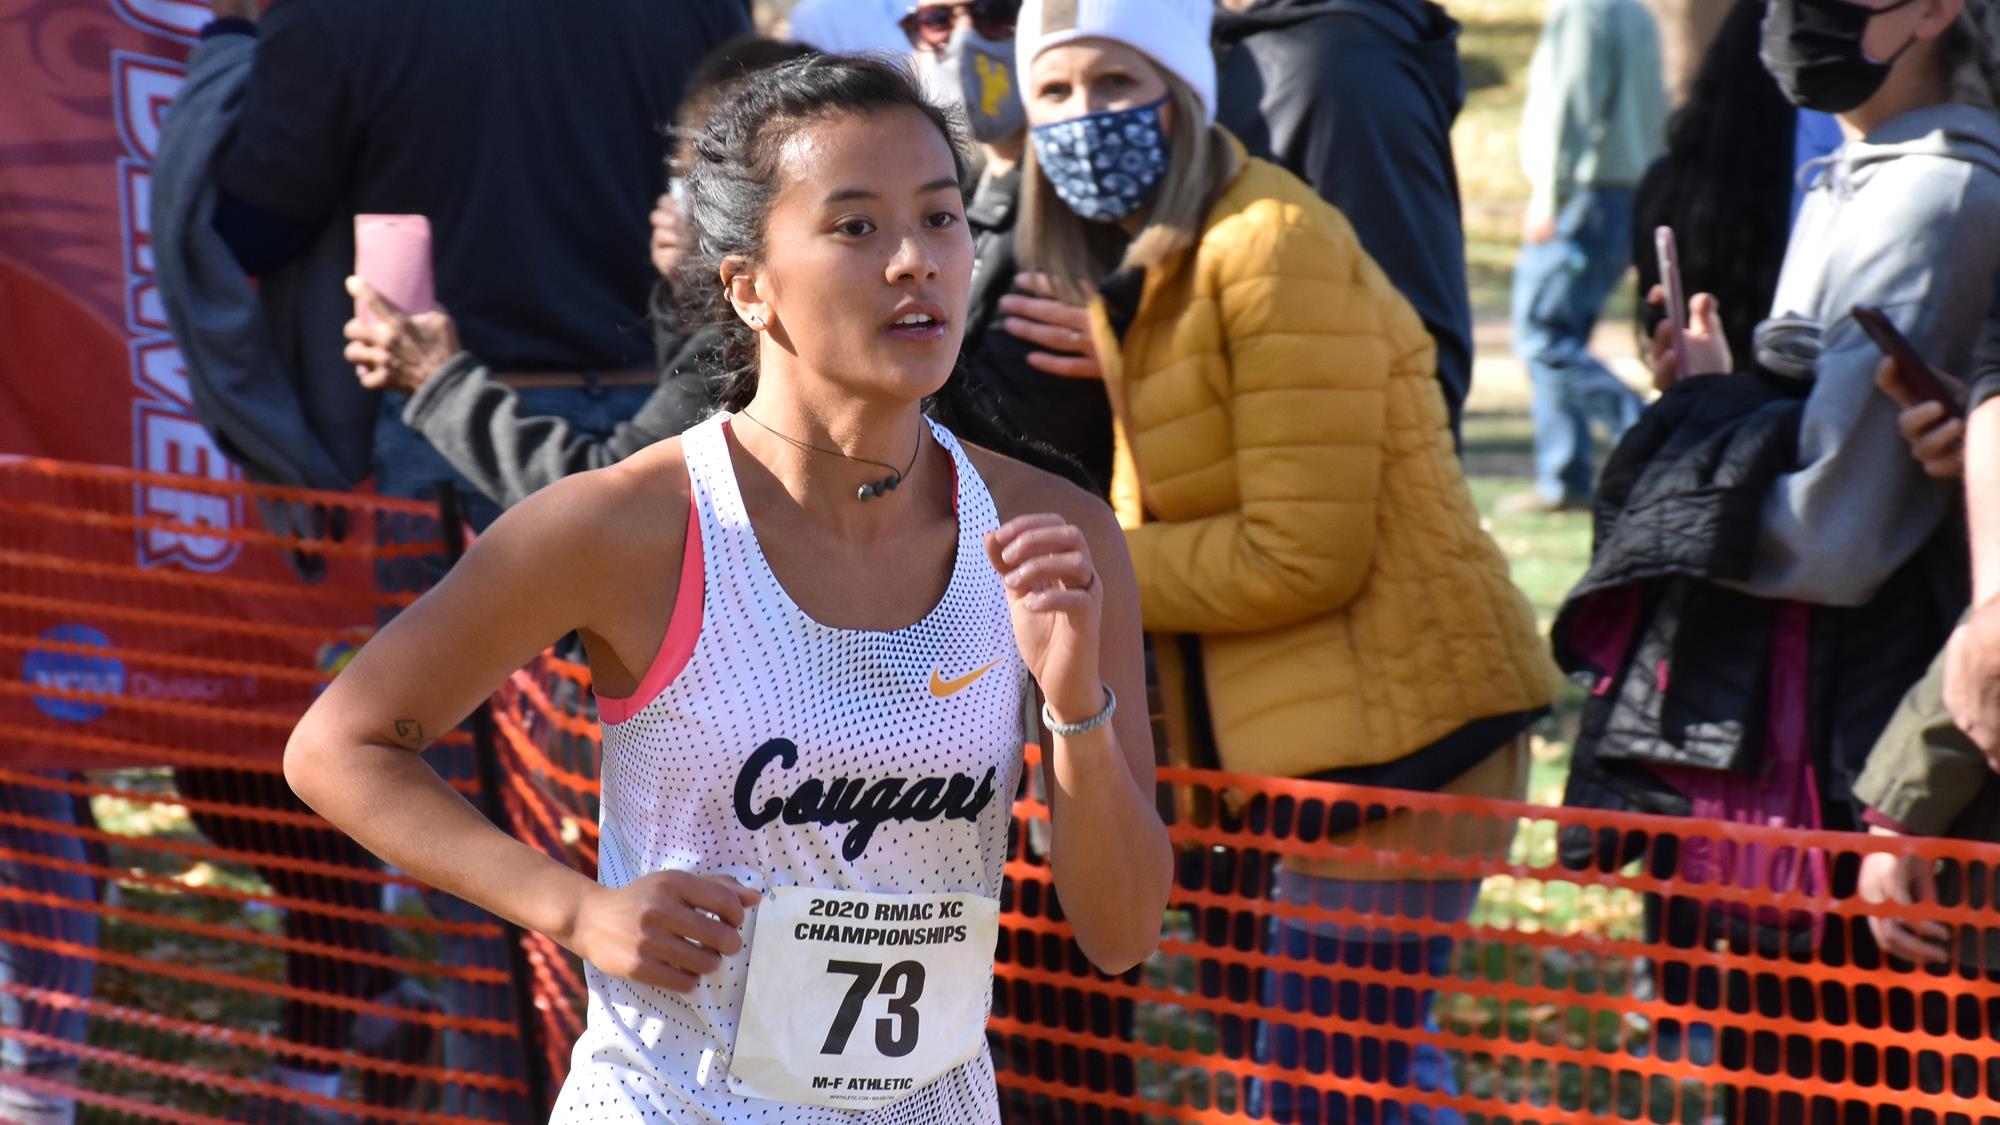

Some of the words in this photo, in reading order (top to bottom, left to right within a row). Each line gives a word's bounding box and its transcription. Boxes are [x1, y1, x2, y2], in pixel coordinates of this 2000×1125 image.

[113, 50, 243, 571] DVER
[733, 737, 996, 861] Cougars
[794, 922, 967, 946] CHAMPIONSHIPS
[809, 898, 869, 919] 2020
[874, 901, 933, 921] RMAC
[939, 901, 963, 918] XC
[819, 959, 926, 1058] 73
[812, 1076, 843, 1089] M-F
[847, 1077, 913, 1091] ATHLETIC
